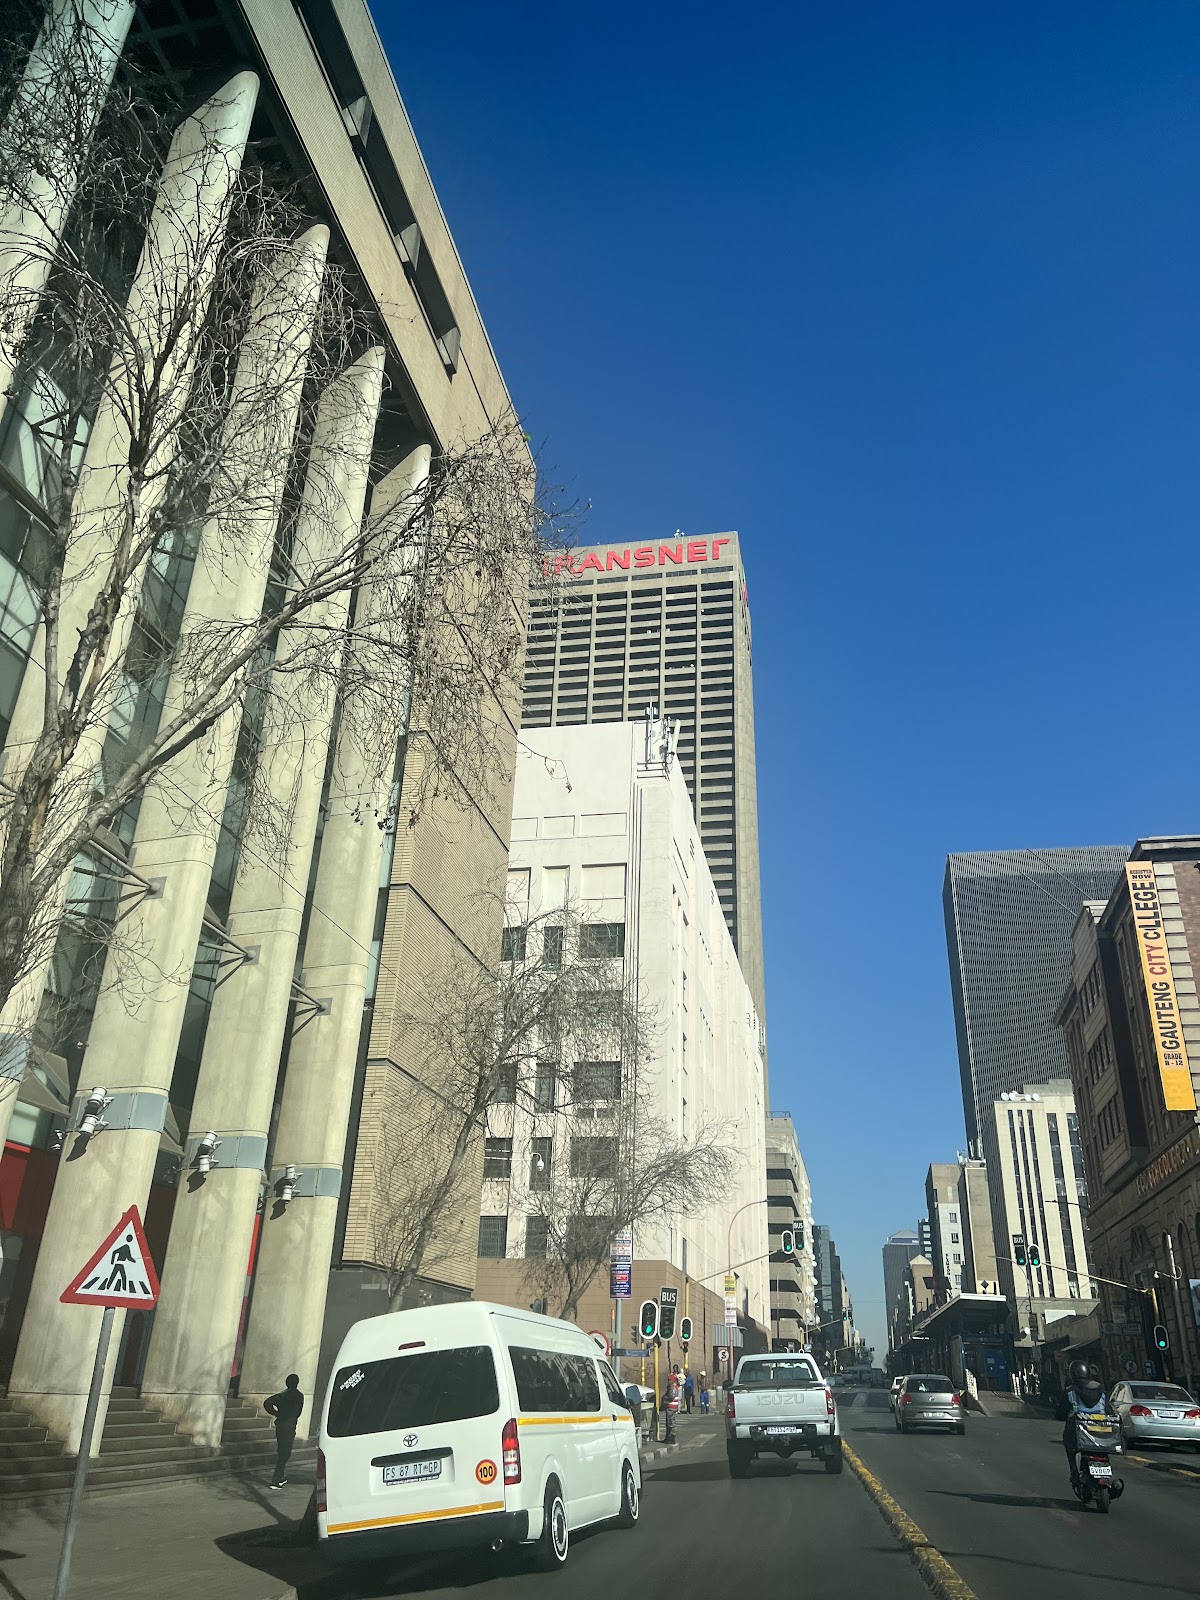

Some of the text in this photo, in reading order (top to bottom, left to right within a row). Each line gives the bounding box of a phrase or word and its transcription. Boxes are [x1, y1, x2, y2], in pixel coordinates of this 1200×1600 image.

[1131, 881, 1181, 1050] GAUTENG CITY CLLEGE
[1163, 1052, 1183, 1060] GRADE
[1013, 1236, 1024, 1244] BUS
[661, 1291, 676, 1303] BUS
[756, 1393, 805, 1406] ISUZU
[385, 1461, 438, 1480] FS 87 RT GP
[479, 1465, 494, 1478] 100
